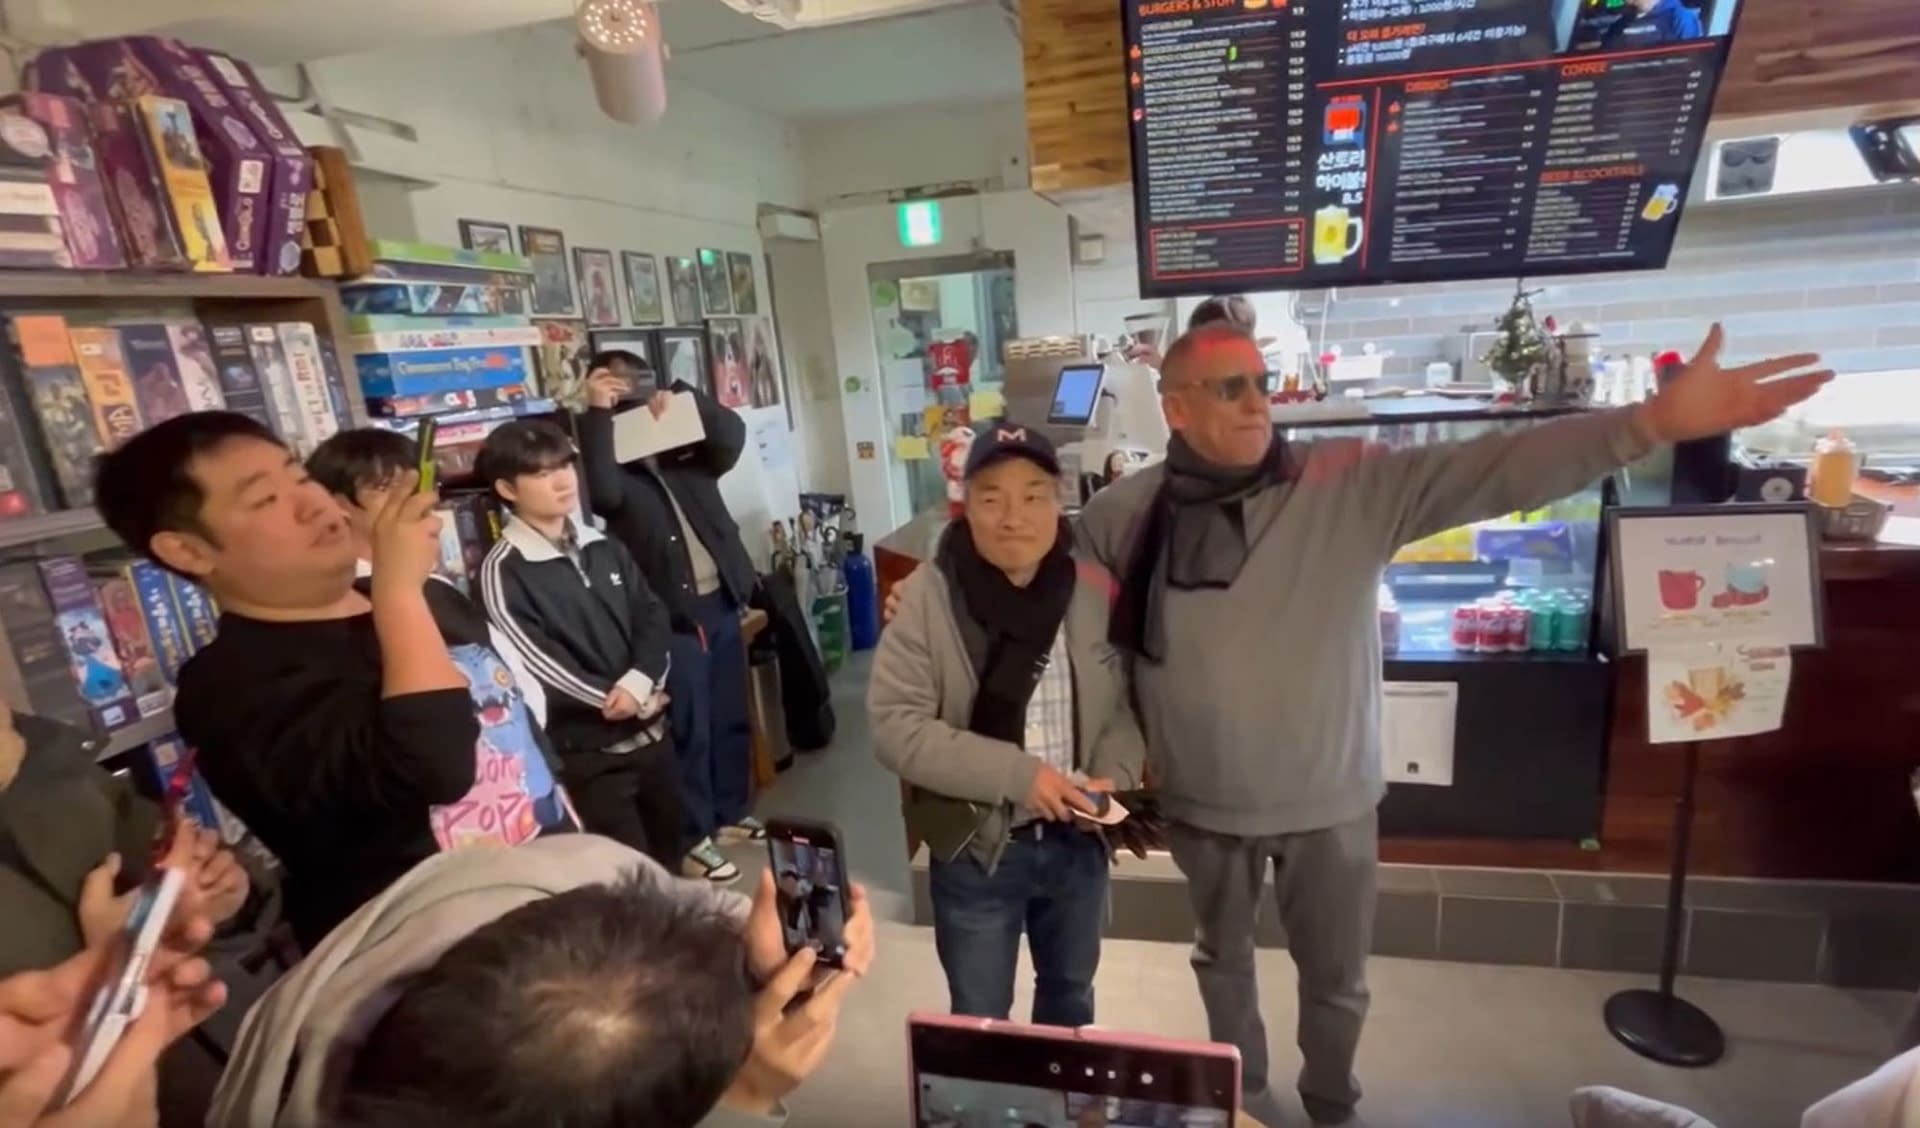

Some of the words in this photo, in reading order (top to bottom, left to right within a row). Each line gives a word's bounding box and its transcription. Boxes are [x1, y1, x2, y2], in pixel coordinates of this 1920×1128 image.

[1138, 1, 1190, 17] BURGERS
[1561, 61, 1608, 77] COFFEE
[1317, 150, 1366, 171] 산토리
[1342, 192, 1364, 205] 8.5
[997, 428, 1027, 442] M
